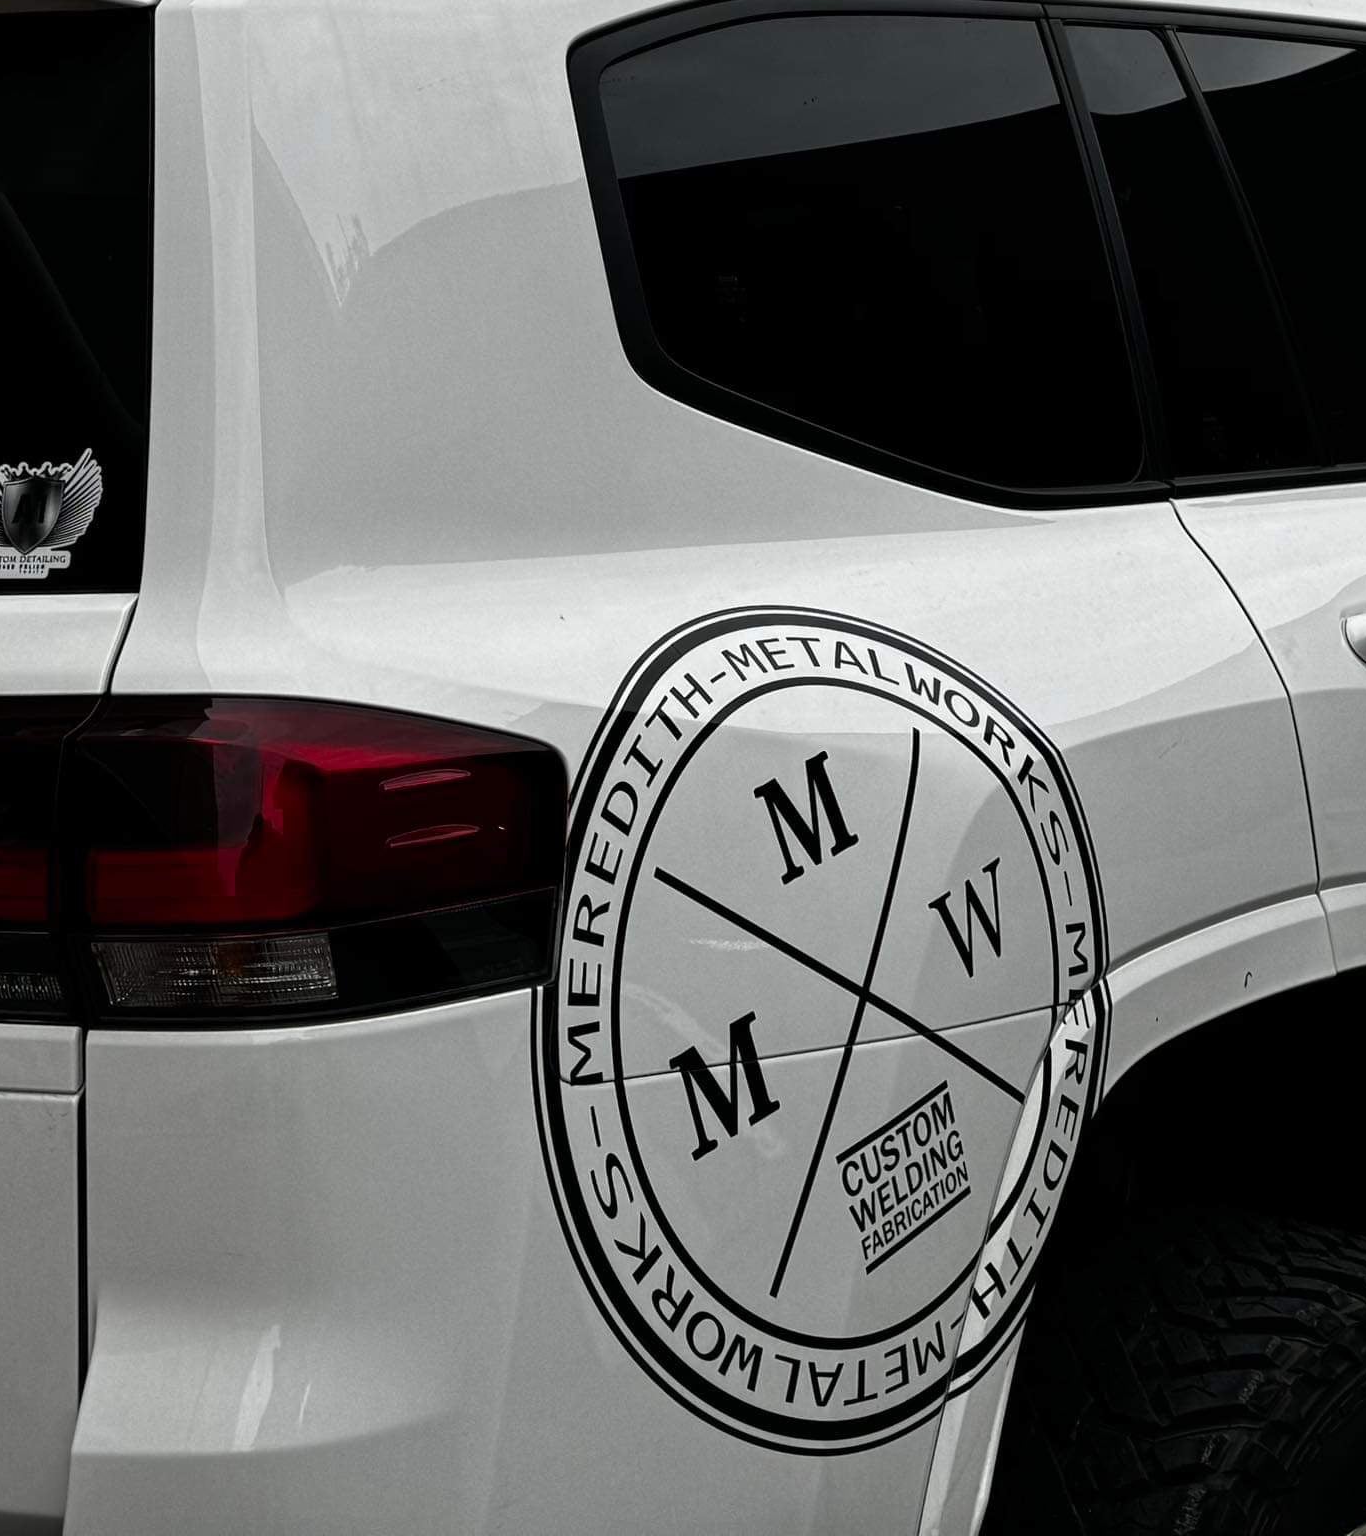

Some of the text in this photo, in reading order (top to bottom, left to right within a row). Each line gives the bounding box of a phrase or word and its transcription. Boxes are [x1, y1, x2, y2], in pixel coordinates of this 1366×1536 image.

[19, 555, 66, 564] DETAILING
[753, 749, 859, 886] M
[927, 857, 1007, 979] W
[667, 1010, 781, 1163] M
[840, 1090, 957, 1186] CUSTOM
[848, 1131, 966, 1233] WELDING
[860, 1161, 970, 1261] FABRICATION
